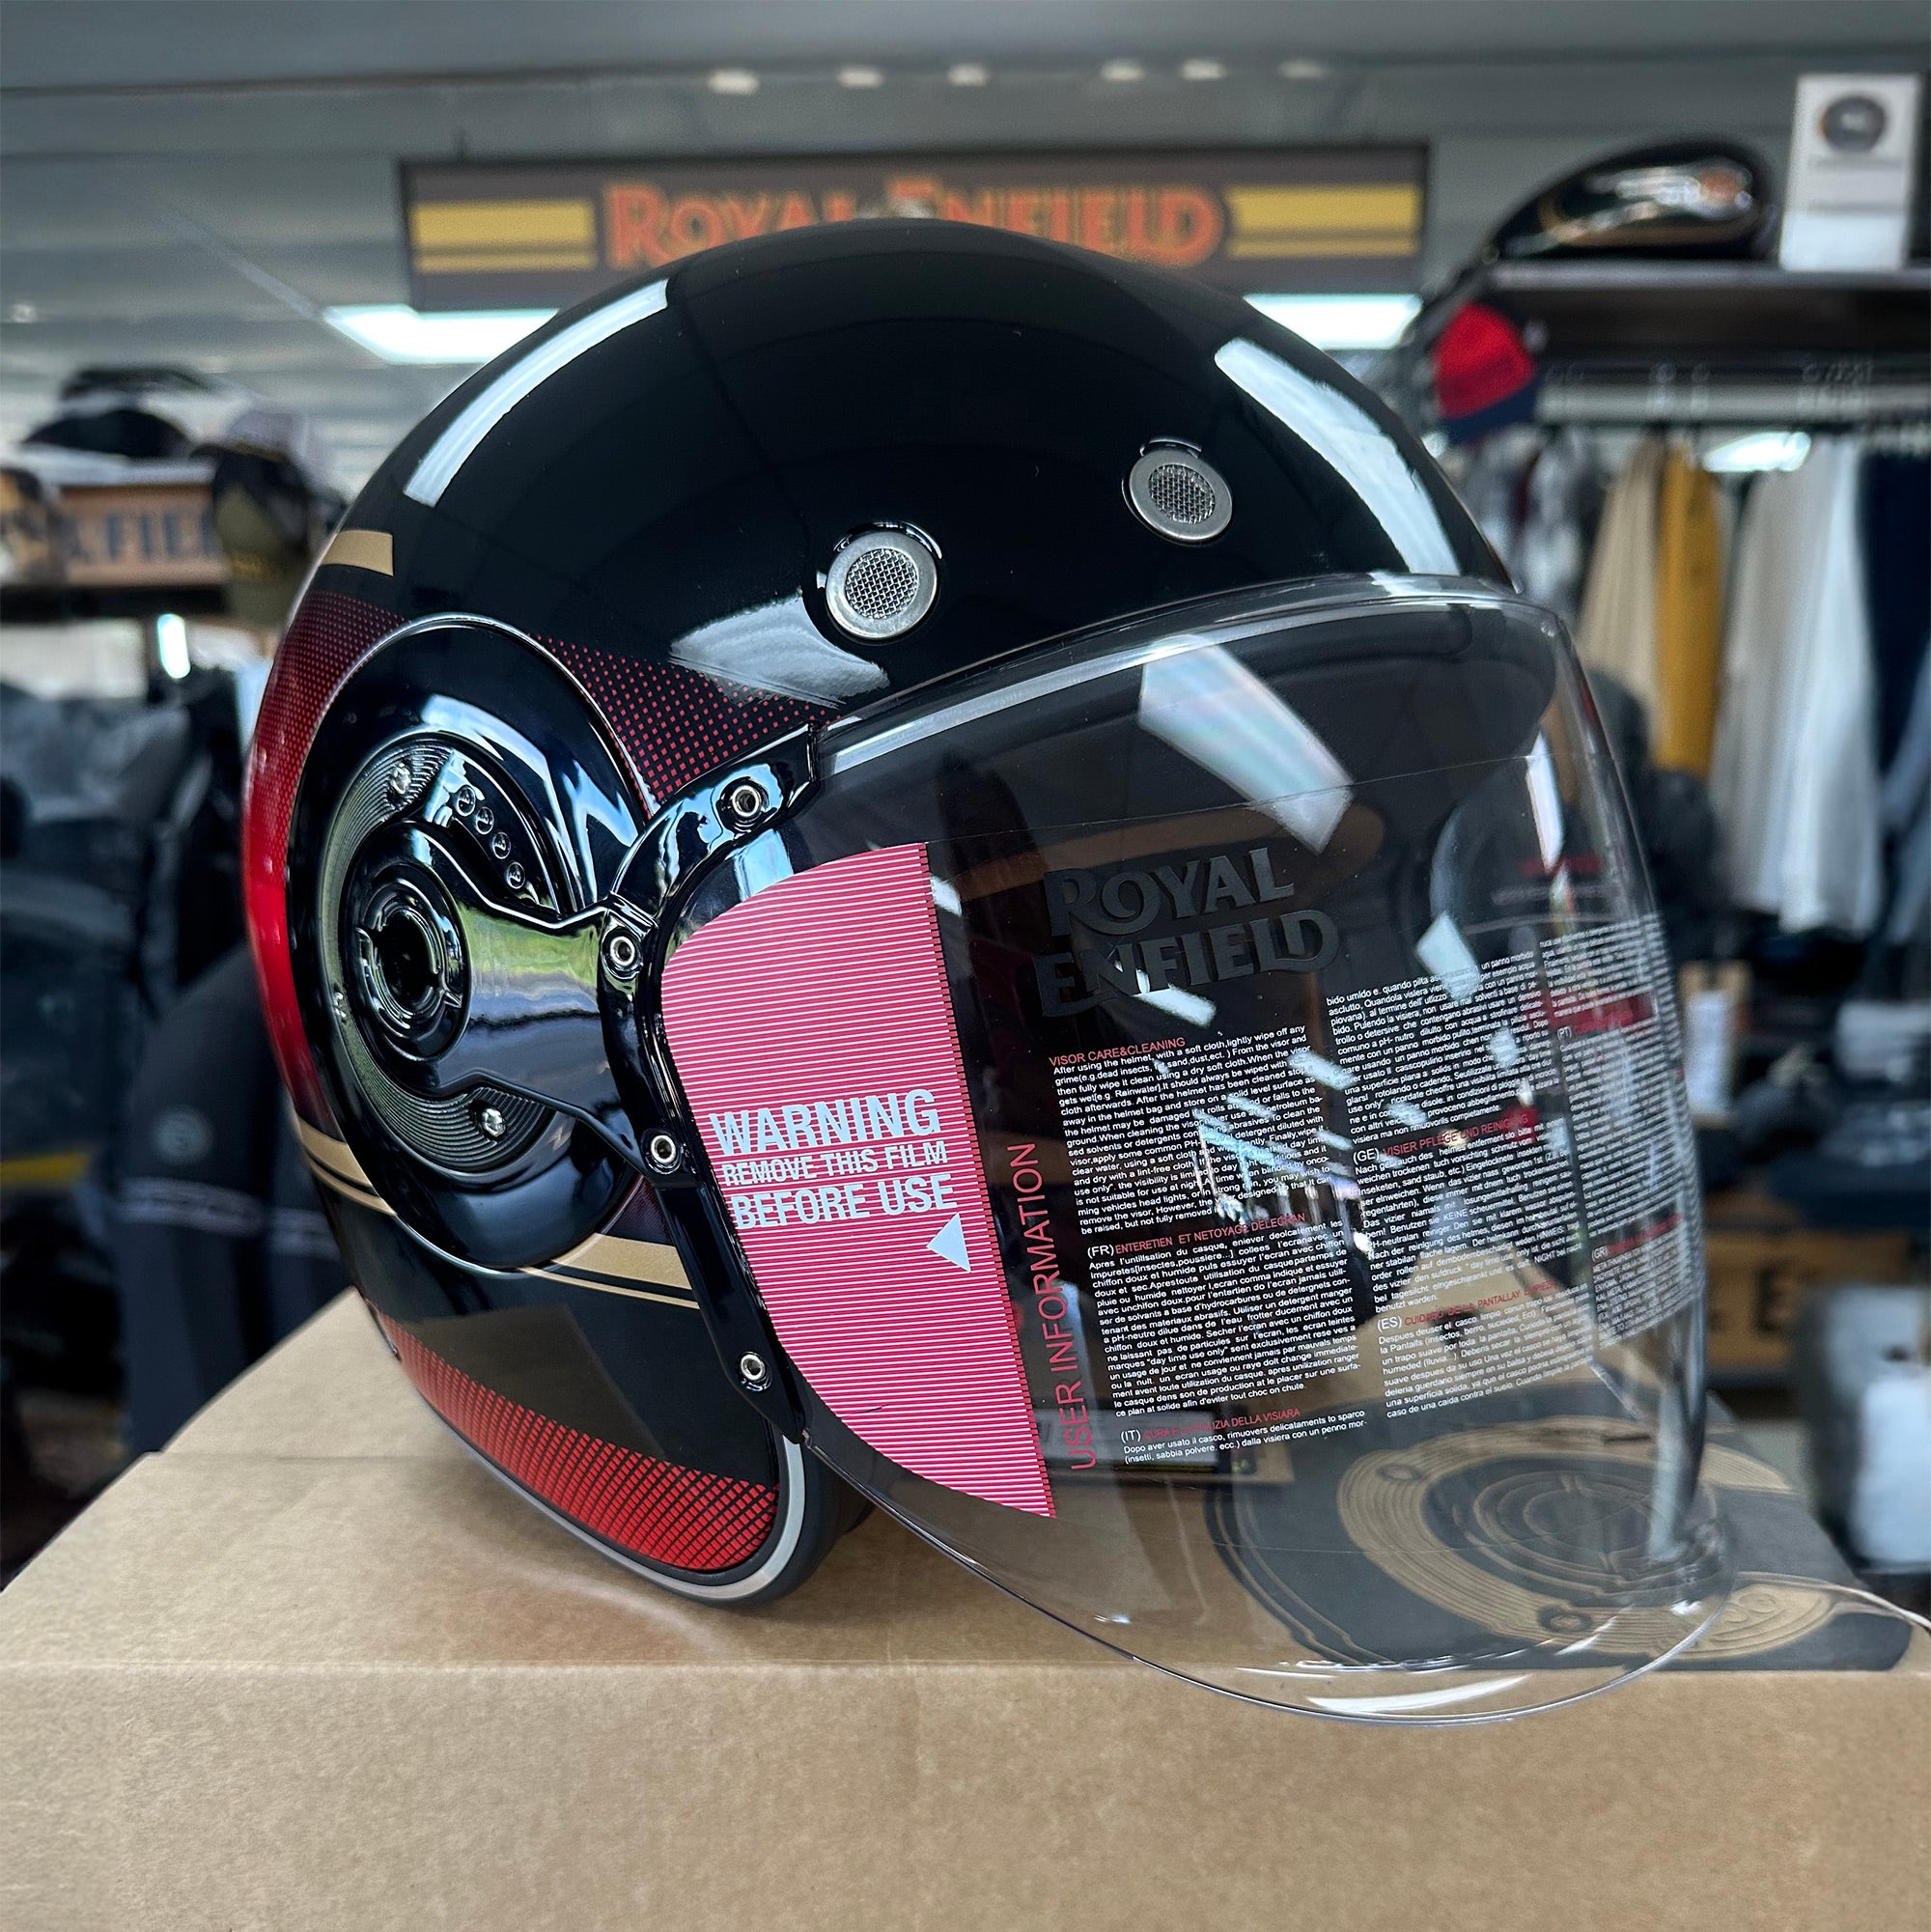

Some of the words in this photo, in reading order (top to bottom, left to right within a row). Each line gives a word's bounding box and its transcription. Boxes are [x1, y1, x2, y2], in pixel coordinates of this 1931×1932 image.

[1043, 848, 1295, 937] ROYAL
[1033, 910, 1340, 1017] ENFIELD
[1326, 995, 1345, 1005] bido
[1382, 980, 1412, 994] quando
[1353, 1017, 1385, 1030] Pulendo
[1049, 1052, 1085, 1066] VISOR
[1087, 1037, 1185, 1060] CARE&CLEANING
[1053, 1066, 1075, 1075] After
[1077, 1062, 1102, 1071] using
[1156, 1050, 1174, 1058] with
[1185, 1045, 1201, 1054] soft
[1253, 1031, 1274, 1041] wipe
[1275, 1027, 1287, 1036] off
[1078, 1083, 1097, 1092] fully
[1098, 1080, 1120, 1089] wipe
[1130, 1076, 1154, 1084] clean
[1156, 1071, 1180, 1080] using
[1206, 1061, 1222, 1072] soft
[1274, 1050, 1288, 1058] the
[1290, 1045, 1310, 1055] visor
[1119, 1065, 1152, 1075] insects,
[1231, 1046, 1253, 1055] From
[1270, 1038, 1289, 1048] visor
[1291, 1034, 1306, 1044] and
[1060, 1106, 1082, 1115] cloth
[1135, 1095, 1158, 1104] After
[1226, 1078, 1249, 1088] been
[1251, 1070, 1285, 1083] cleaned
[1344, 1086, 1359, 1095] una
[709, 1089, 941, 1156] WARNING
[723, 1156, 817, 1187] REMOVE
[823, 1148, 879, 1176] THIS
[884, 1140, 948, 1170] FILM
[1353, 1147, 1380, 1164] (GE)
[1433, 1158, 1449, 1167] tuch
[731, 1183, 870, 1230] BEFORE
[877, 1174, 958, 1216] USE
[1007, 1143, 1079, 1372] INFORMATION
[1087, 1244, 1114, 1259] (FR)
[1115, 1237, 1172, 1253] ENTERETIEN
[1178, 1233, 1190, 1244] ET
[1390, 1246, 1404, 1255] der
[1092, 1278, 1123, 1288] chiffon
[1125, 1274, 1148, 1283] doux
[1292, 1246, 1313, 1254] avec
[1101, 1325, 1129, 1334] tenant
[1320, 1287, 1352, 1299] manger
[1377, 1315, 1402, 1332] (ES)
[1385, 1398, 1401, 1407] una
[1386, 1408, 1406, 1417] caso
[1055, 1381, 1097, 1470] USER
[1120, 1429, 1140, 1443] (IT)
[1167, 1439, 1189, 1447] usato
